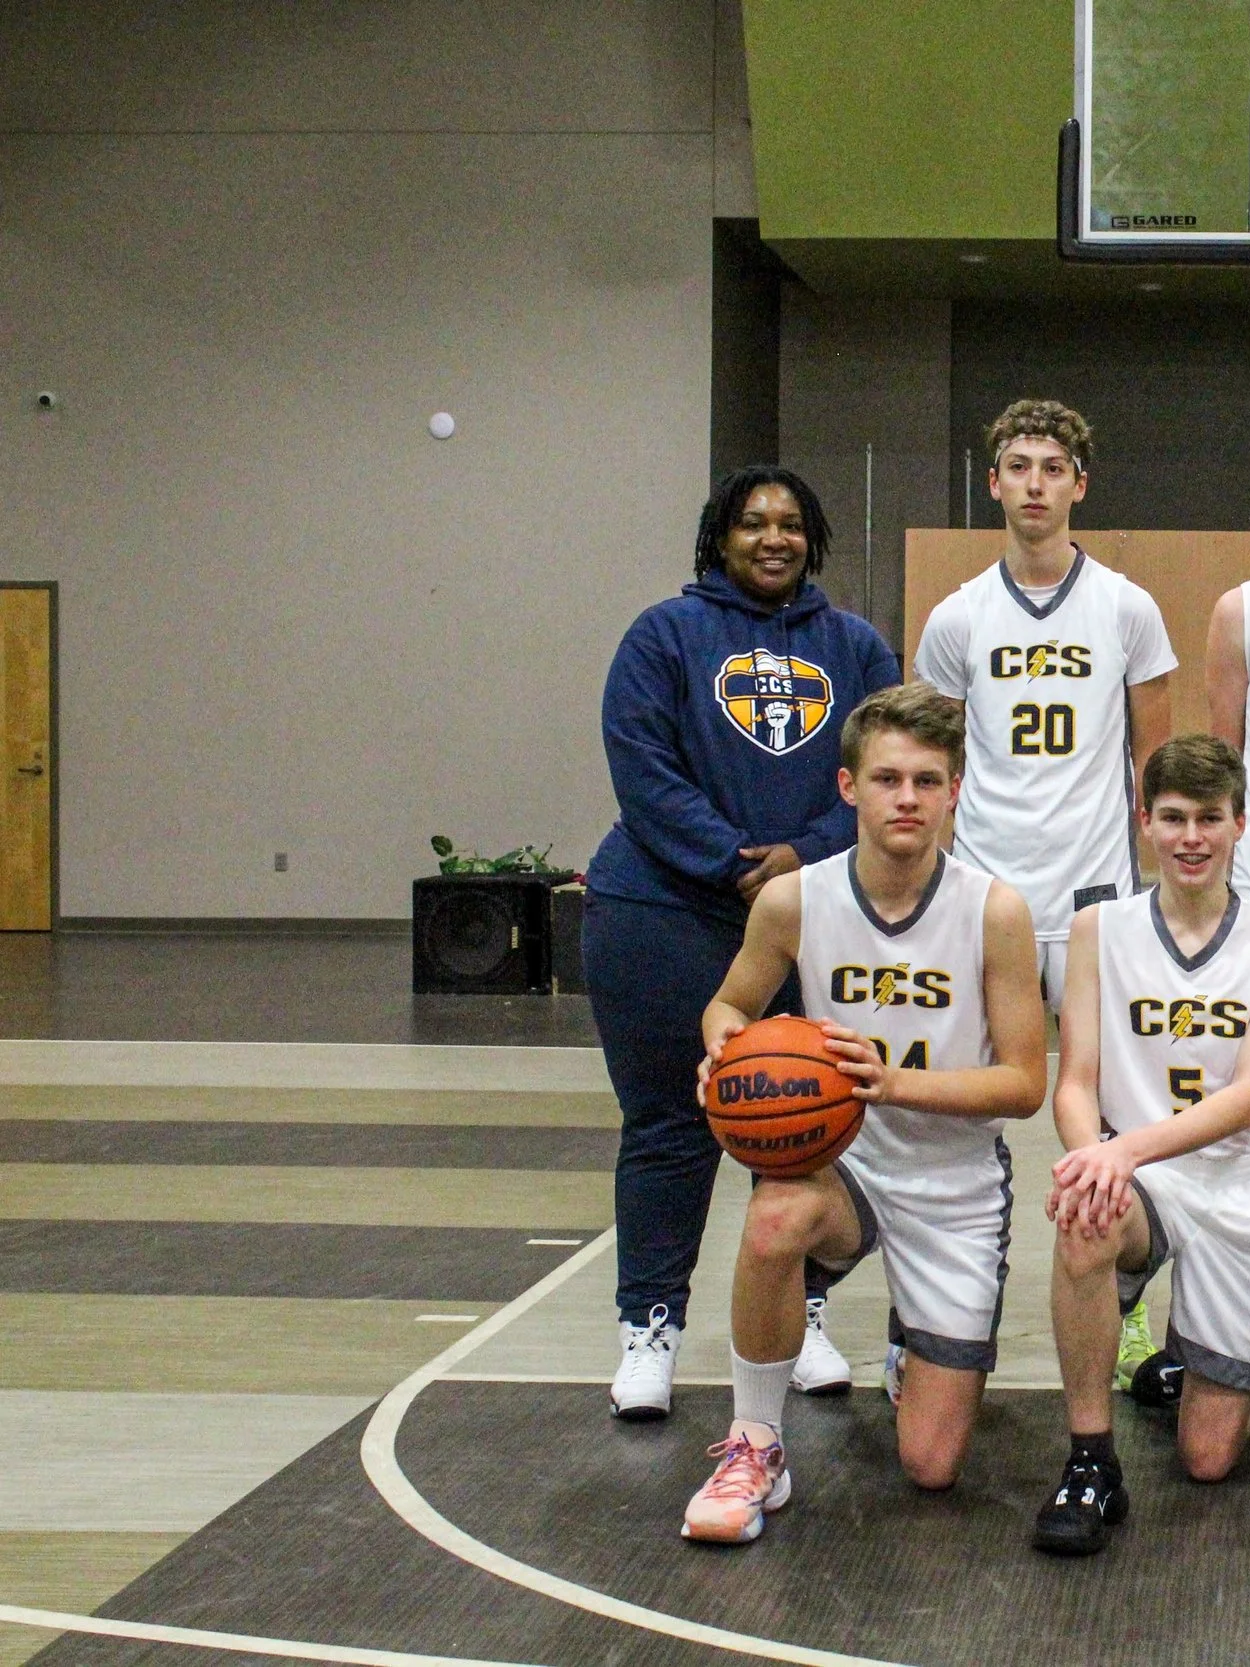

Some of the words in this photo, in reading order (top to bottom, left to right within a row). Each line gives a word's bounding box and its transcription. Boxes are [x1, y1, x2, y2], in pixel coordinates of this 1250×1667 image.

[1133, 215, 1197, 226] GARED
[989, 643, 1092, 679] CCS
[755, 676, 794, 695] CCS
[1011, 702, 1076, 756] 20
[830, 963, 952, 1010] CCS
[1128, 997, 1248, 1039] CCS
[717, 1069, 822, 1105] Wilson
[1168, 1066, 1206, 1116] 5
